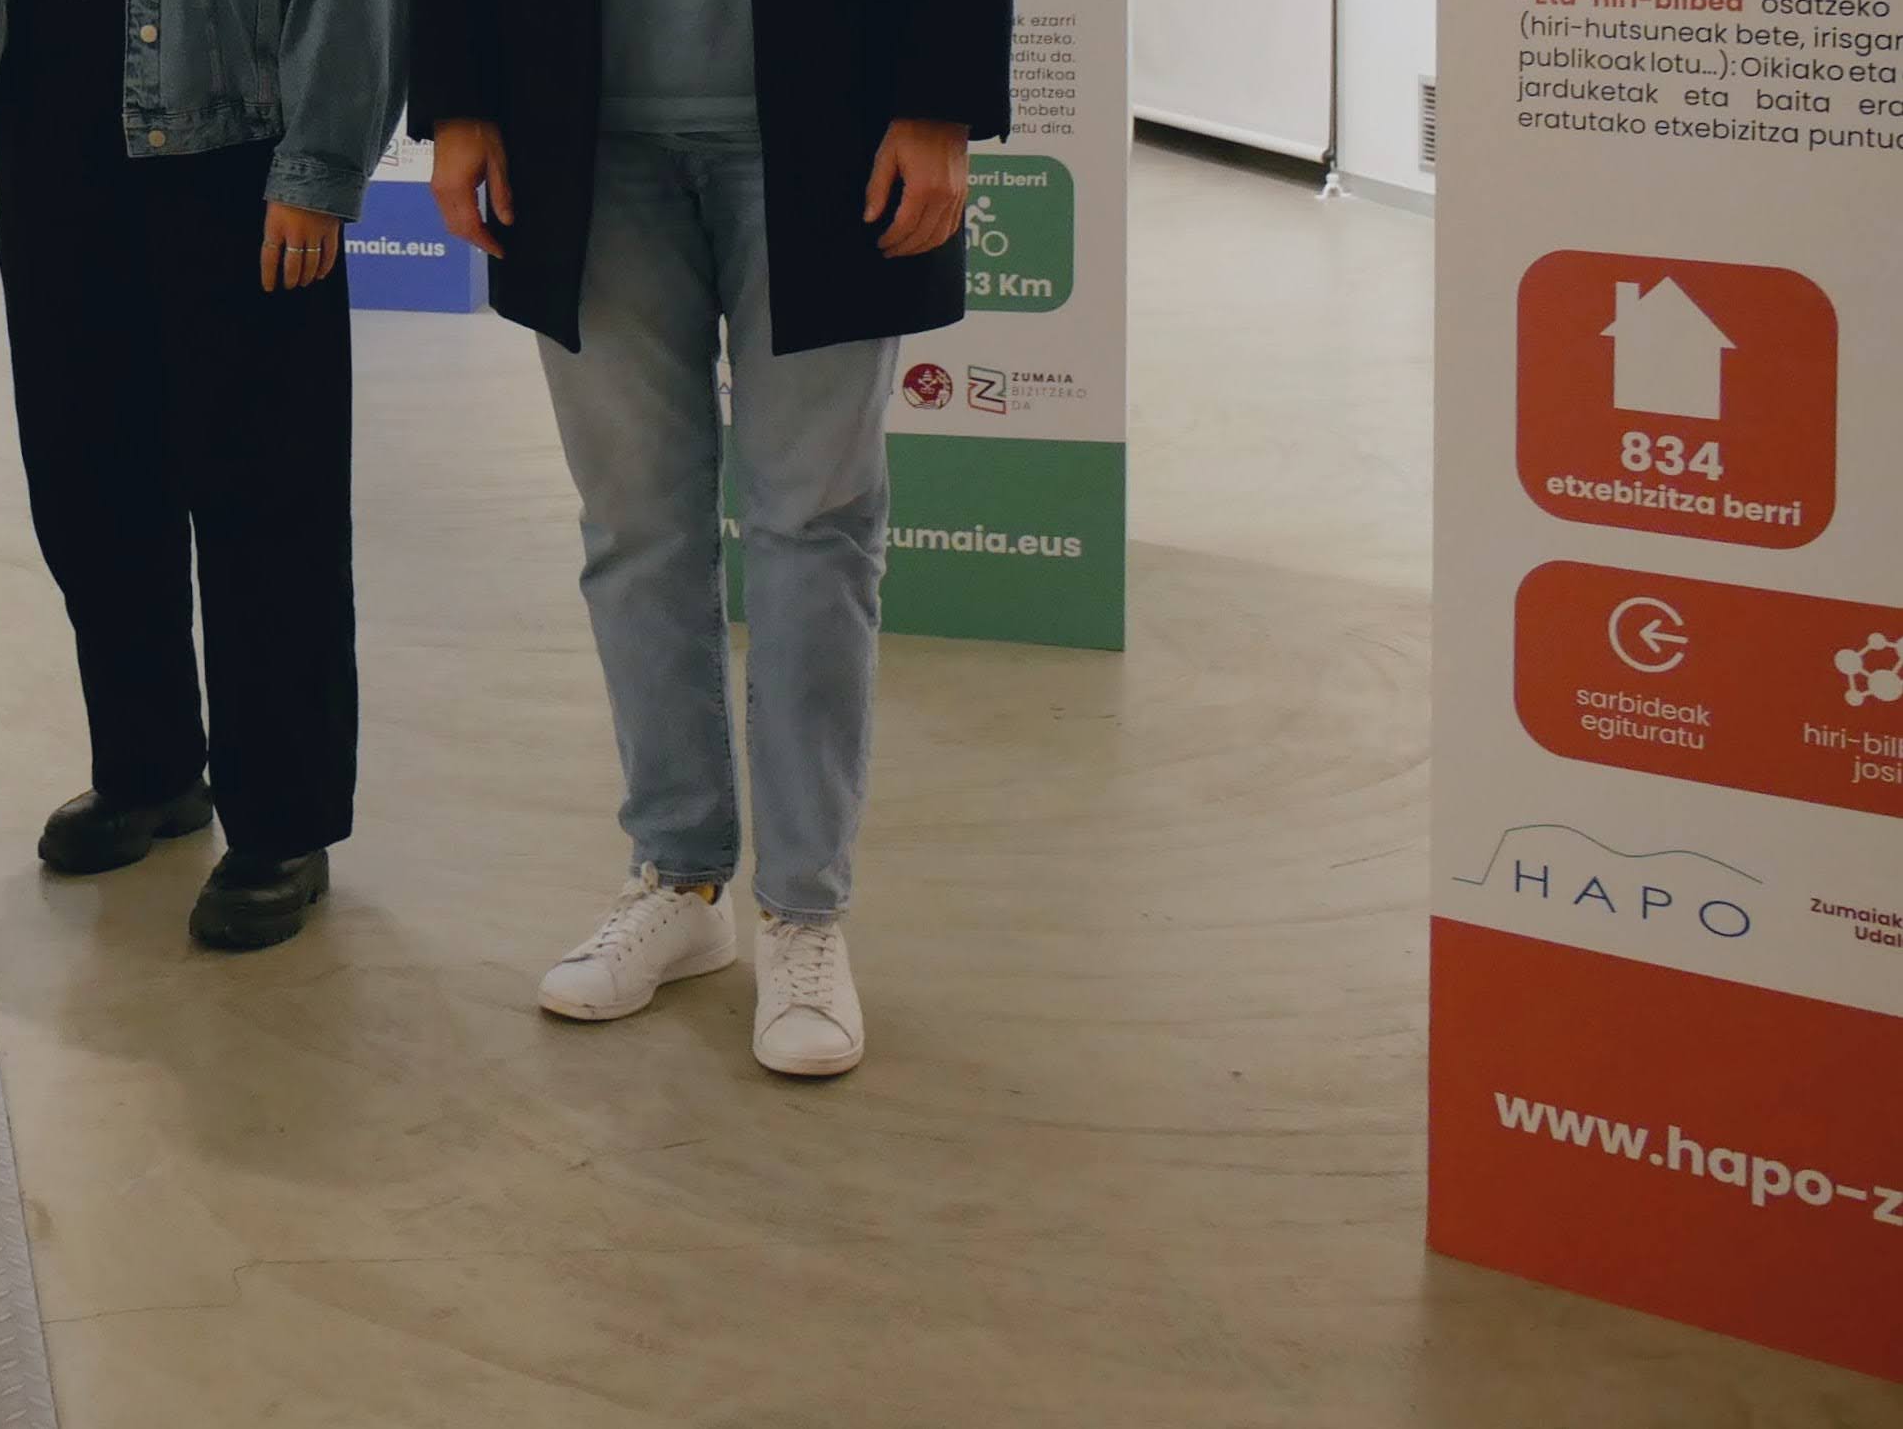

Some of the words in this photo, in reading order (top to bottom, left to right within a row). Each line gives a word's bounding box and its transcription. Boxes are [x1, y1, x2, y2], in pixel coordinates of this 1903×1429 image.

[1030, 14, 1076, 27] ezarri
[1520, 10, 1728, 44] (hiri-hutsuneak
[1736, 23, 1805, 50] bete,
[1013, 68, 1075, 80] trafikoa
[1519, 47, 1646, 72] publikoak
[1741, 56, 1844, 81] Oikiako
[1849, 63, 1896, 83] eta
[1018, 103, 1075, 116] hobetu
[1516, 76, 1658, 104] jarduketak
[1684, 87, 1728, 107] eta
[1757, 89, 1830, 113] baita
[1518, 111, 1646, 134] eratutako
[1655, 117, 1799, 143] etxebizitza
[1003, 171, 1047, 187] berri
[999, 273, 1052, 297] Km
[1012, 372, 1073, 383] ZUMAIA
[1621, 431, 1723, 481] 834
[1547, 475, 1715, 515] etxebizitza
[1723, 494, 1801, 526] berri
[1576, 689, 1710, 729] sarbideak
[1581, 709, 1707, 749] egituratu
[1515, 860, 1750, 937] HAPO
[1494, 1092, 1903, 1226] www.hapo-z
